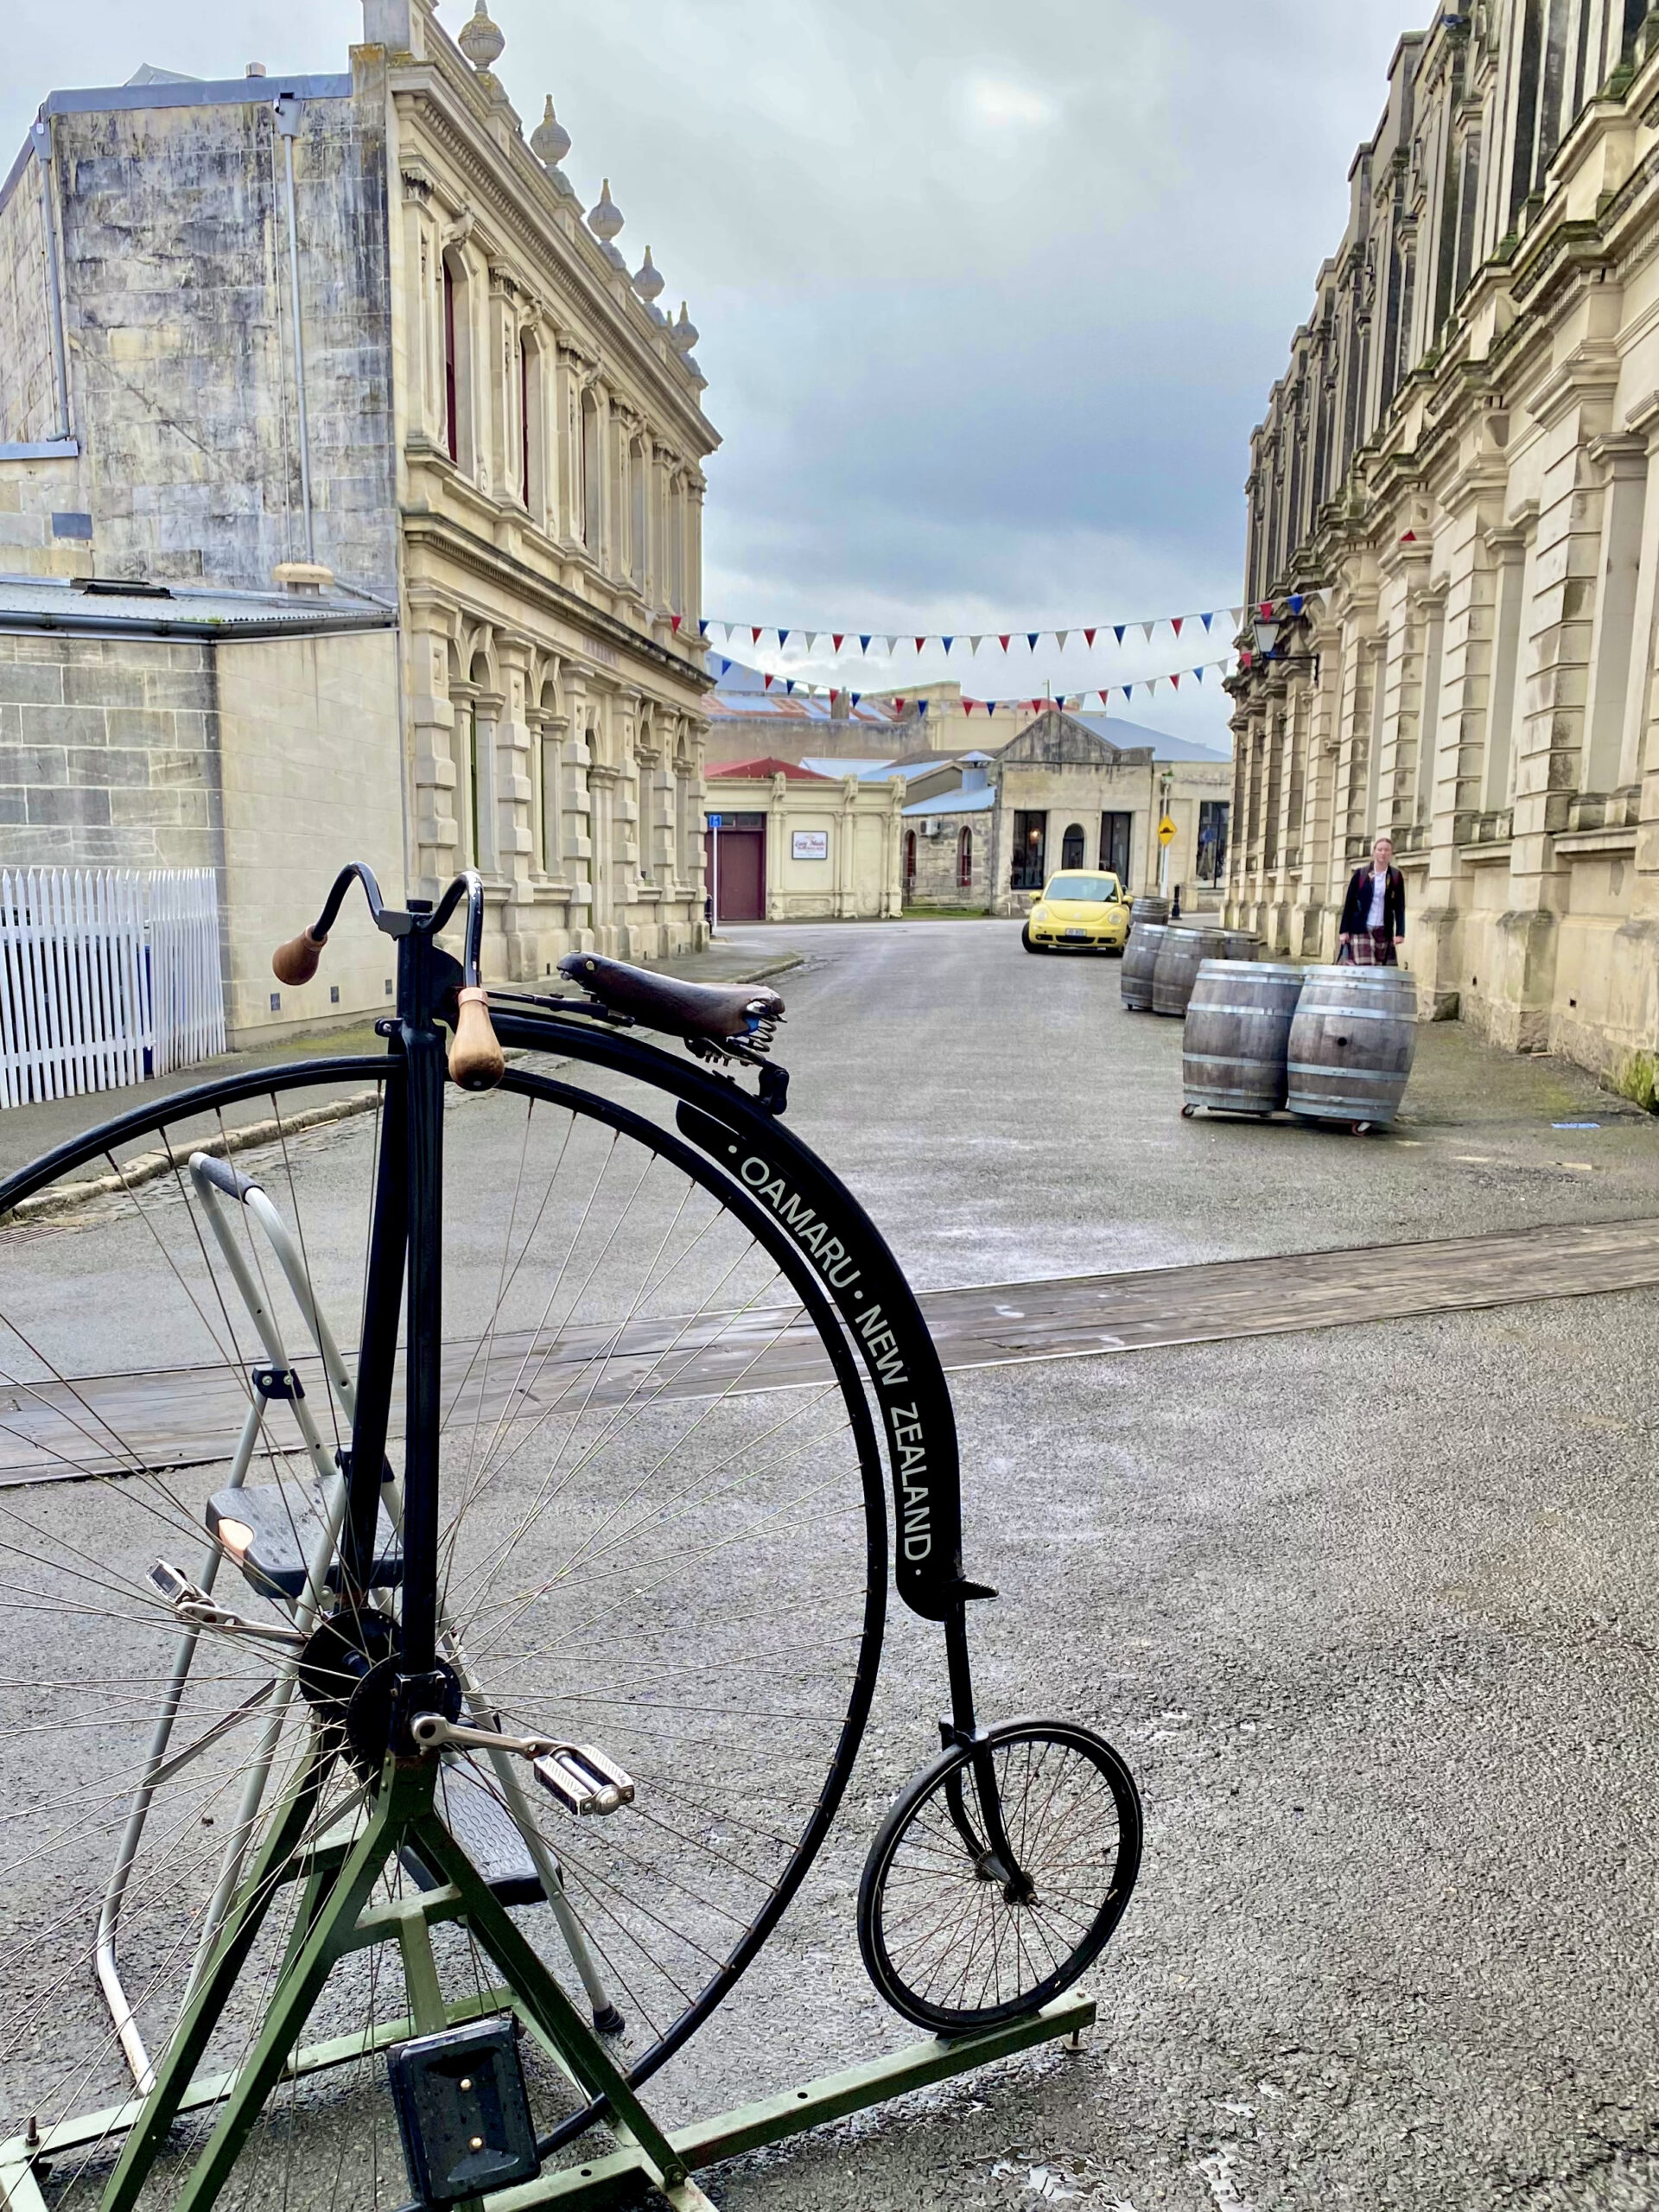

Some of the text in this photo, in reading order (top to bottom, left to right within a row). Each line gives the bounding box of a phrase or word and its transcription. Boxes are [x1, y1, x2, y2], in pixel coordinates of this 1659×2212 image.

[741, 1156, 931, 1560] OAMARU NEW ZEALAND
